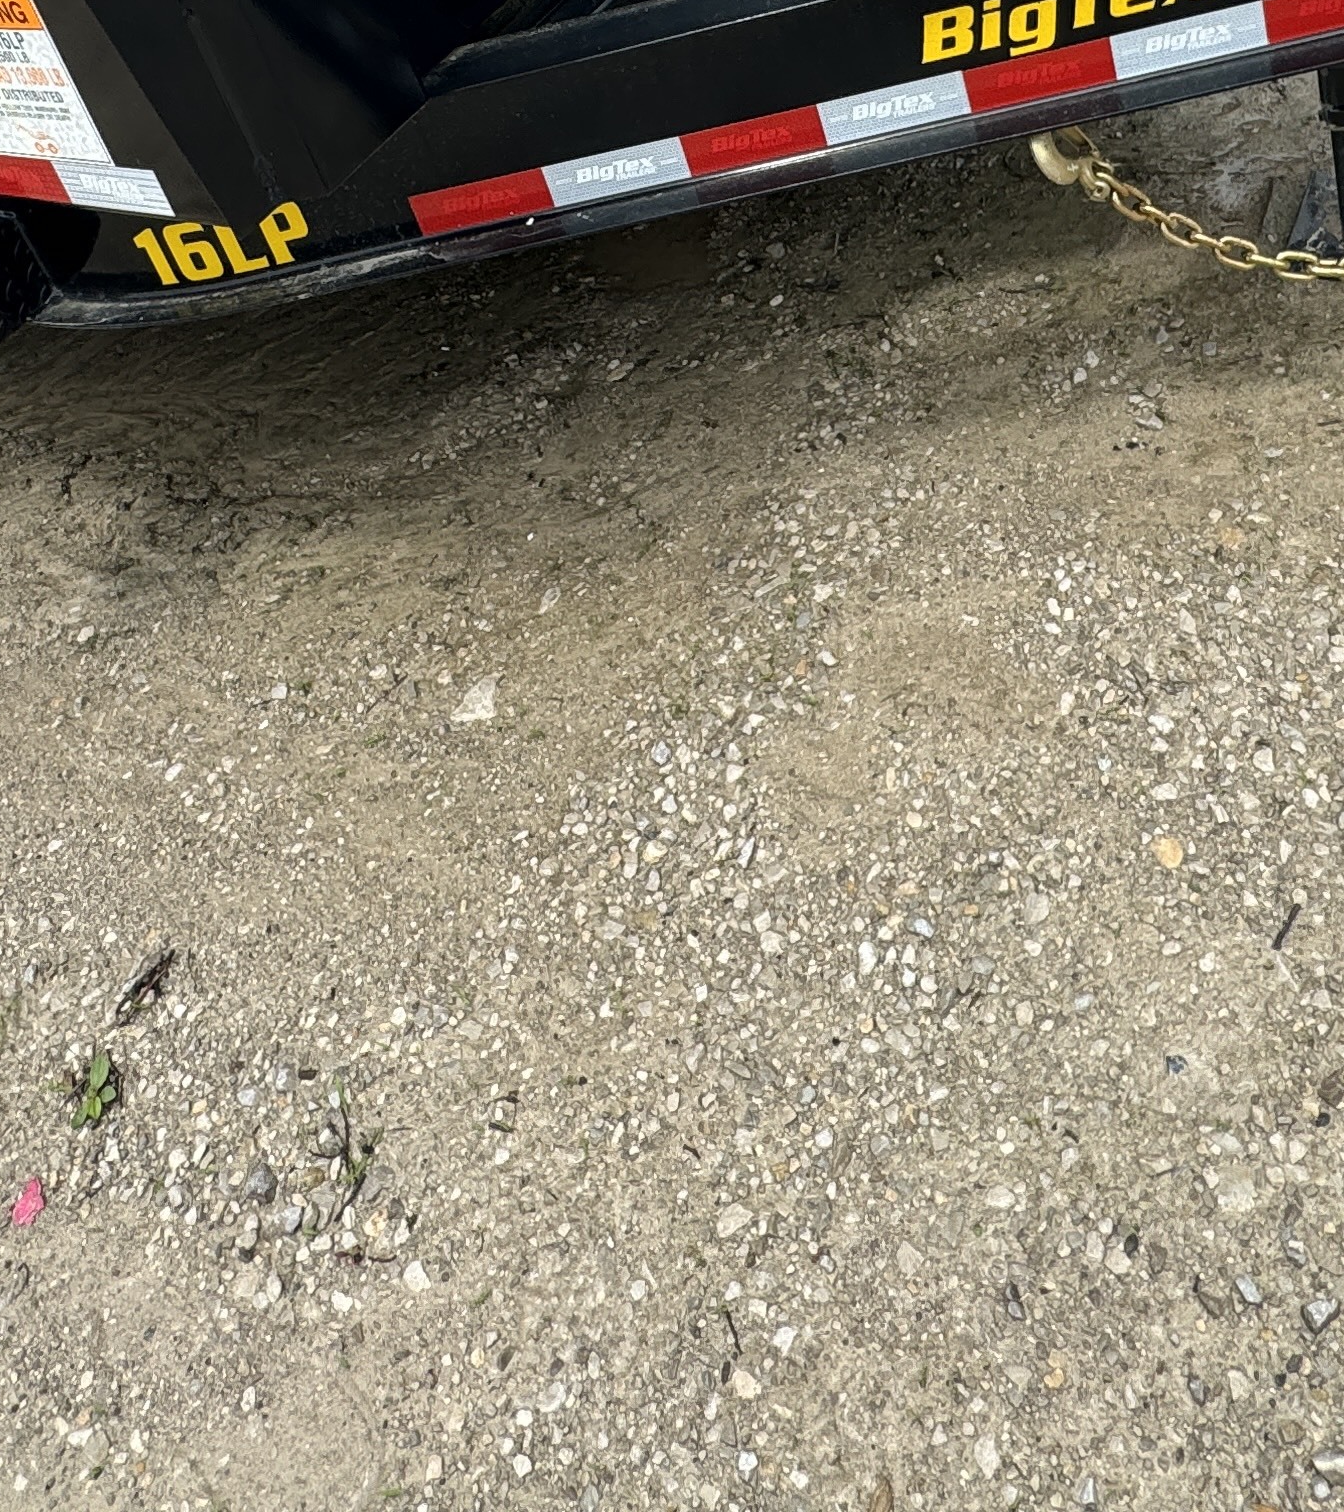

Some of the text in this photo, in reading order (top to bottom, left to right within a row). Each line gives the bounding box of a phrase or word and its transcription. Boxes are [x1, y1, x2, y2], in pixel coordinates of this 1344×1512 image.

[1145, 21, 1232, 54] BigTex
[0, 88, 64, 103] DISTRIBUTED
[852, 91, 934, 122] BigTex
[575, 155, 656, 184] BigTex
[133, 201, 309, 286] 16LP
